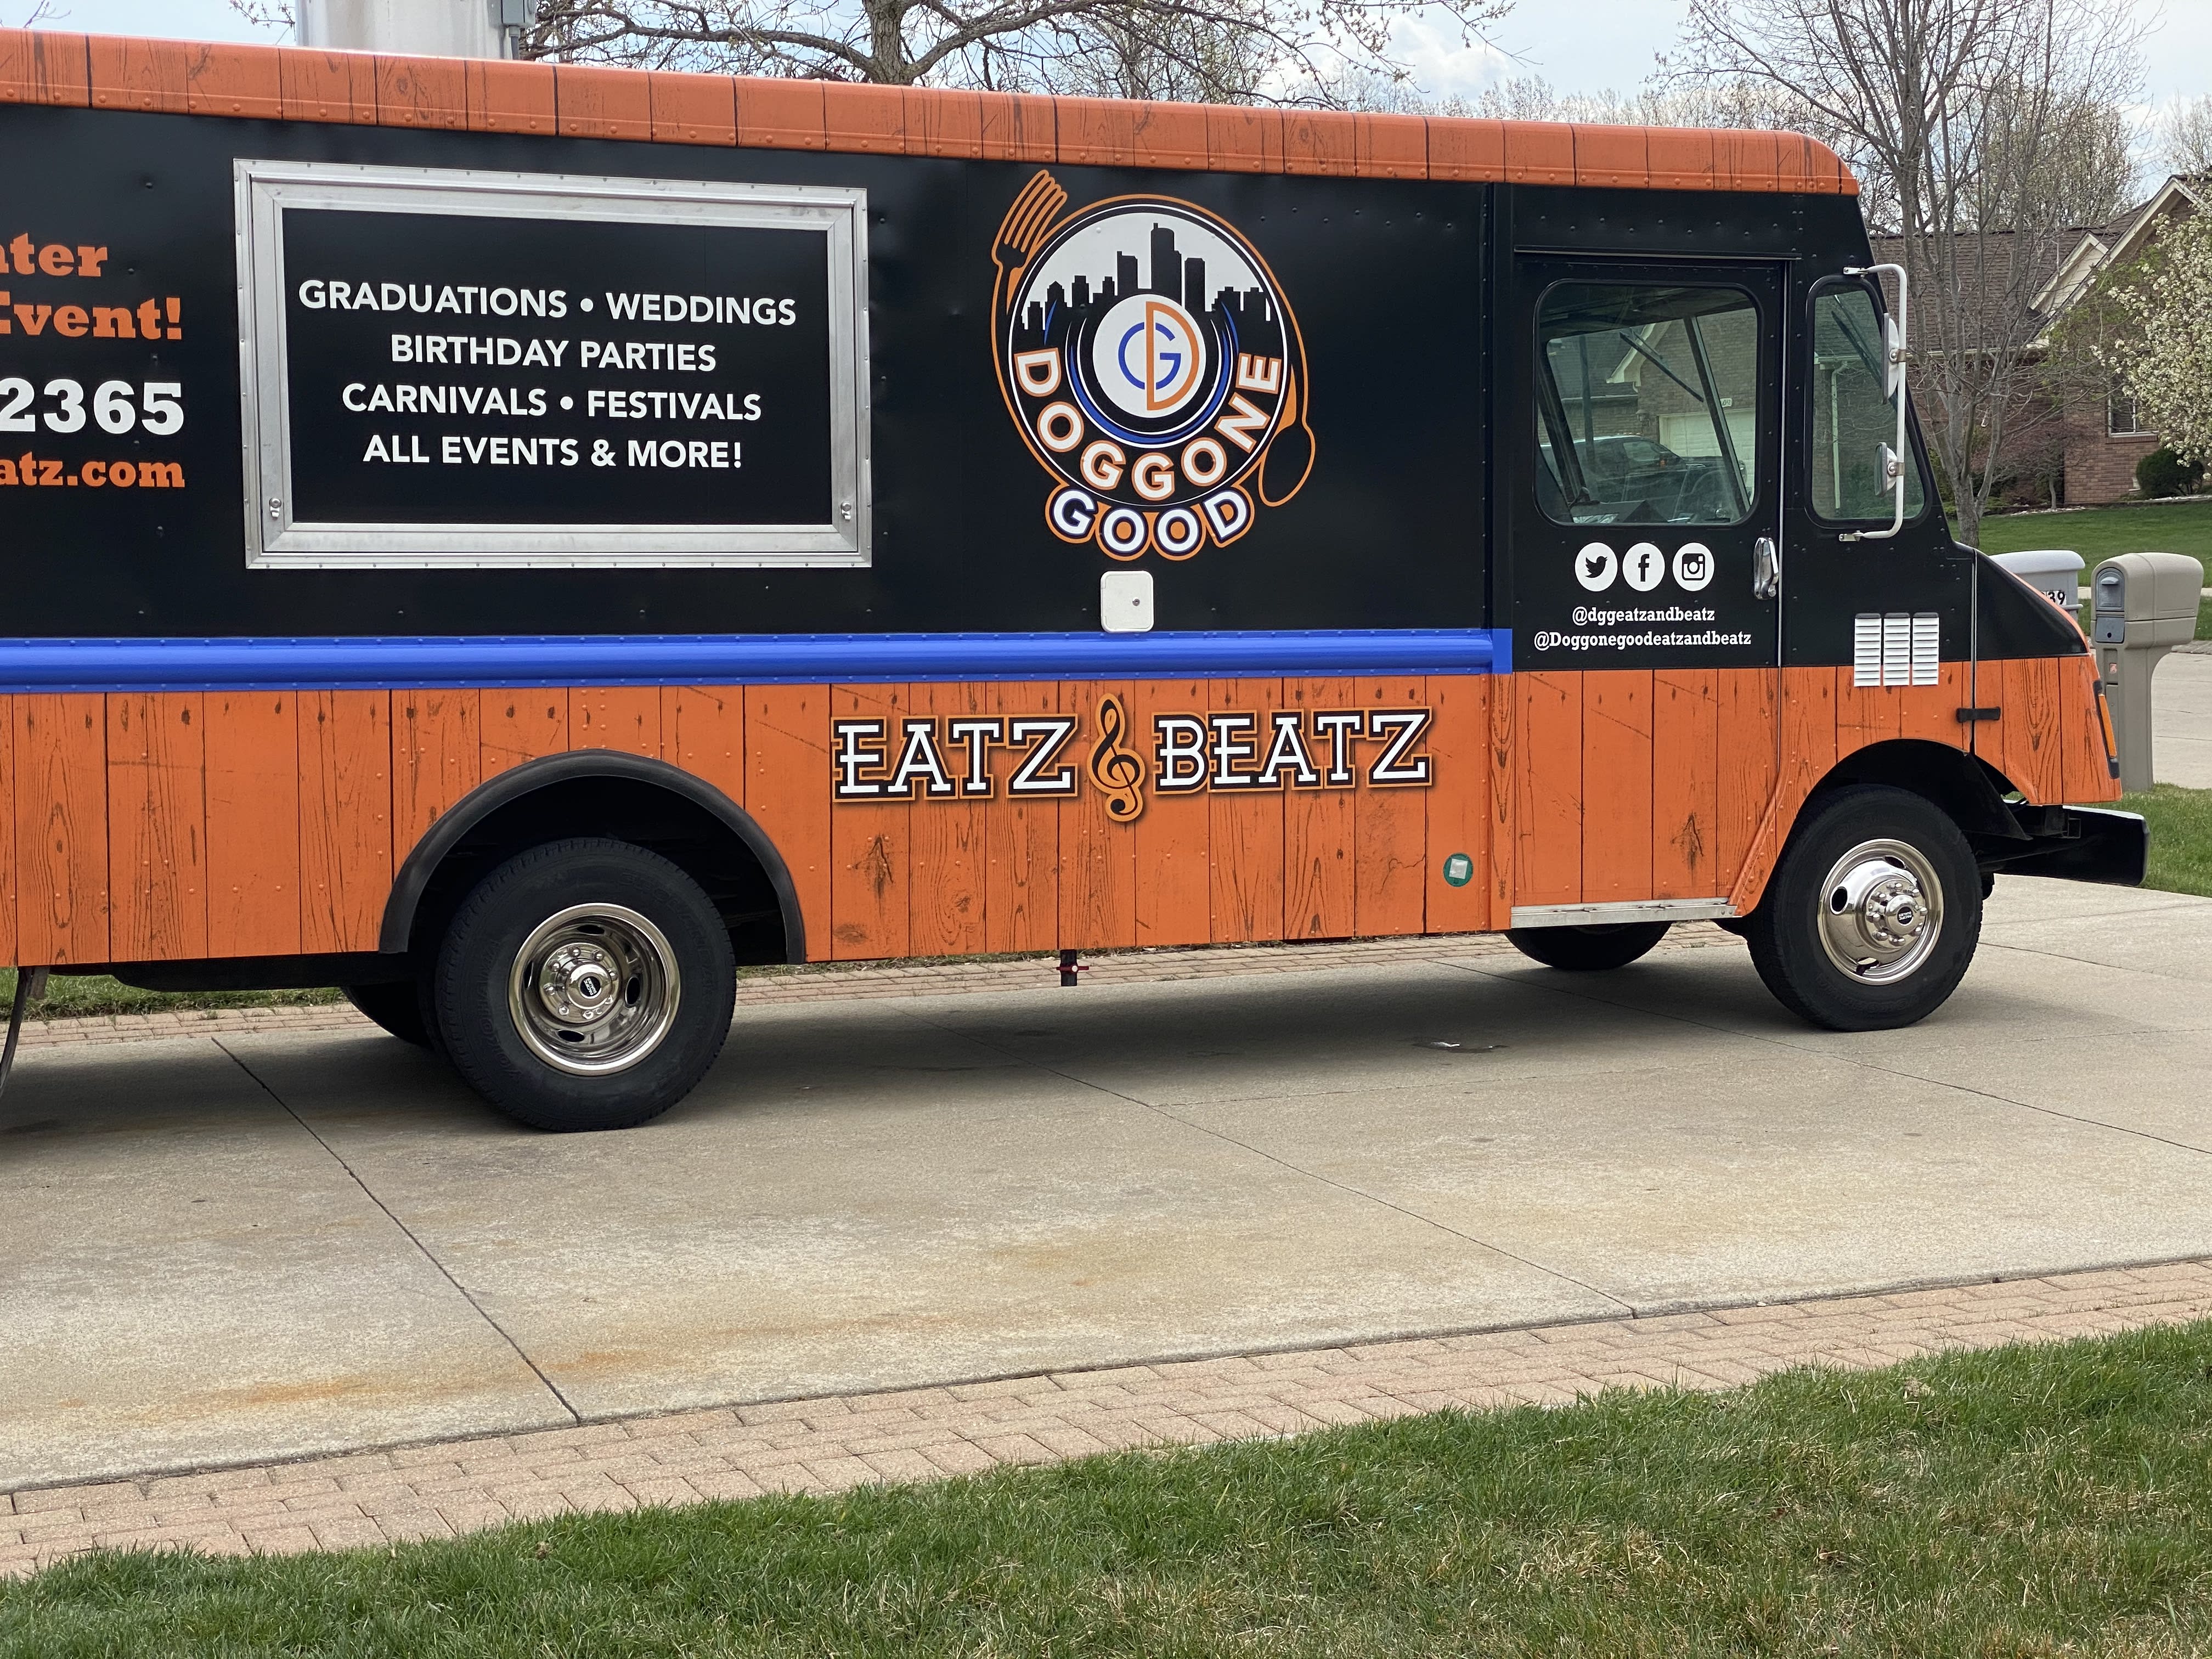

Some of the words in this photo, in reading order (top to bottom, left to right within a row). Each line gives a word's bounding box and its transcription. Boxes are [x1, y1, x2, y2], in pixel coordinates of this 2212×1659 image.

[0, 233, 108, 277] ter
[298, 279, 567, 318] GRADUATIONS
[605, 292, 796, 326] WEDDINGS
[391, 334, 569, 367] BIRTHDAY
[580, 341, 716, 372] PARTIES
[0, 377, 184, 436] 2365
[342, 383, 547, 416] CARNIVALS
[588, 390, 761, 421] FESTIVALS
[1014, 348, 1280, 500] DOGGONE
[363, 435, 430, 465] ALL
[442, 436, 579, 467] EVENTS
[591, 439, 617, 467] &
[628, 440, 741, 469] MORE!
[1051, 487, 1249, 554] GOOD
[1572, 606, 1715, 626] @dggeatzandbeatz
[2041, 591, 2066, 605] 39
[1534, 630, 1752, 651] @Doggonegoodeatzandbeatz
[834, 716, 1075, 799] EATZ
[1155, 708, 1430, 793] BEATZ
